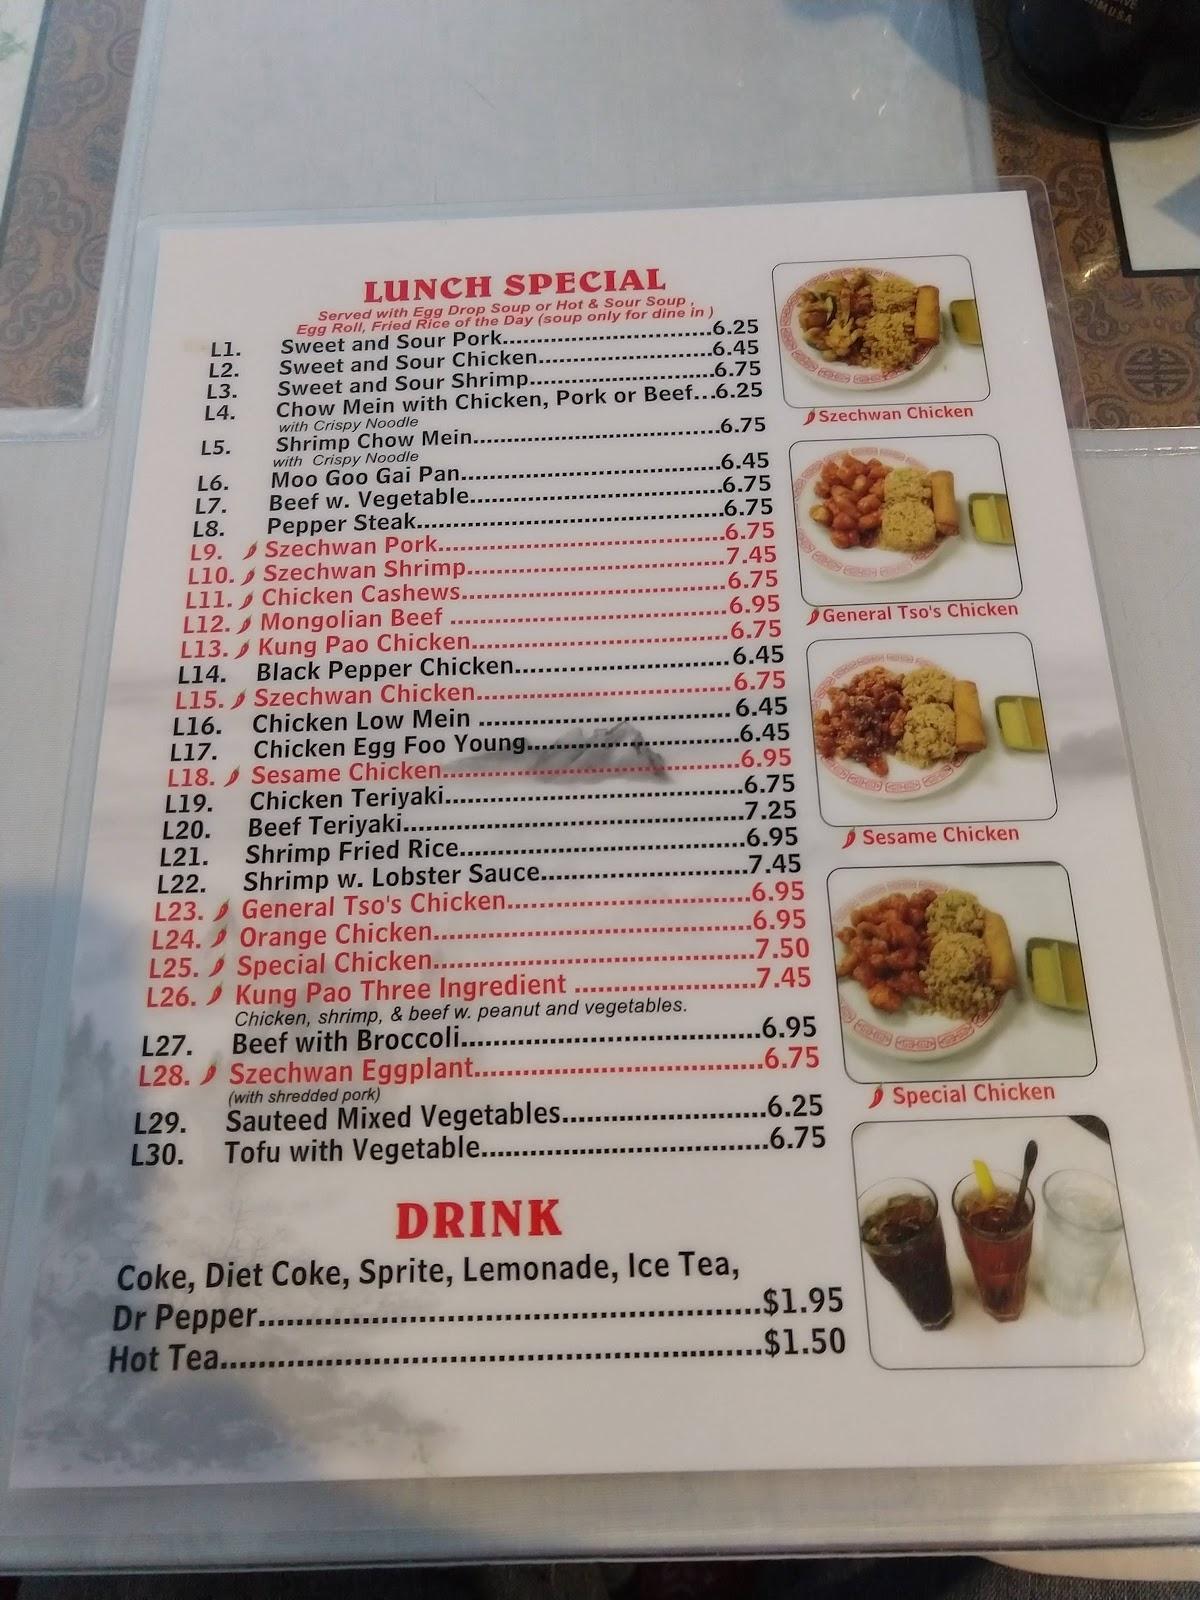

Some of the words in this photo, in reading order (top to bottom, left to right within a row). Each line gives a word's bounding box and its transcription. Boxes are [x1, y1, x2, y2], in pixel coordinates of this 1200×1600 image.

[364, 276, 492, 303] LUNCH
[503, 268, 666, 296] SPECIAL
[296, 324, 327, 337] Egg
[329, 321, 370, 334] Roll,
[371, 319, 412, 332] Fried
[416, 317, 450, 329] Rice
[455, 316, 472, 327] of
[475, 315, 499, 327] the
[503, 314, 534, 327] Day
[537, 311, 583, 325] (soup
[587, 310, 621, 323] only
[625, 309, 648, 320] for
[652, 307, 685, 319] dine
[318, 309, 371, 322] Served
[374, 308, 408, 320] with
[413, 306, 443, 320] Egg
[448, 305, 485, 318] Drop
[491, 303, 530, 316] Soup
[536, 303, 552, 312] or
[556, 300, 583, 311] Hot
[588, 299, 599, 309] &
[604, 298, 641, 309] Sour
[211, 341, 241, 357] L1.
[281, 338, 345, 354] Sweet
[352, 335, 389, 352] and
[396, 334, 446, 349] Sour
[453, 329, 502, 347] Pork
[712, 319, 759, 336] 6.25
[207, 383, 237, 399] L3.
[277, 379, 343, 397] Sweet
[349, 376, 387, 393] and
[395, 375, 445, 391] Sour
[451, 371, 528, 389] Shrimp
[714, 360, 761, 378] 6.75
[205, 404, 235, 421] L4.
[276, 401, 336, 418] Chow
[343, 397, 394, 415] Mein
[402, 395, 447, 412] with
[455, 392, 548, 410] Chicken,
[556, 388, 607, 406] Pork
[614, 391, 637, 403] or
[644, 384, 693, 402] Beef
[714, 381, 763, 399] 6.25
[818, 407, 902, 423] Szechwan
[907, 405, 973, 419] Chicken
[201, 440, 231, 456] L5.
[276, 435, 350, 455] Shrimp
[357, 432, 414, 452] Chow
[422, 429, 472, 446] Mein
[719, 416, 766, 434] 6.75
[279, 421, 308, 433] with
[314, 419, 362, 433] Crispy
[365, 416, 419, 429] Noodle
[197, 474, 229, 492] L6.
[271, 471, 318, 489] Moo
[325, 469, 368, 486] Goo
[376, 466, 411, 484] Gai
[419, 466, 459, 483] Pan
[720, 452, 769, 470] 6.45
[273, 455, 303, 468] with
[313, 454, 362, 468] Crispy
[365, 451, 419, 464] Noodle
[193, 520, 224, 538] L8.
[267, 517, 347, 537] Pepper
[353, 512, 416, 531] Steak
[723, 498, 773, 517] 6.75
[191, 543, 222, 561] L9.
[265, 538, 376, 558] Szechwan
[385, 535, 437, 554] Pork
[724, 521, 775, 541] 6.75
[183, 615, 230, 634] L12.
[261, 610, 382, 633] Mongolian
[391, 607, 443, 627] Beef
[729, 594, 780, 614] 6.95
[822, 606, 892, 623] General
[897, 605, 942, 619] Tso's
[947, 602, 1018, 618] Chicken
[176, 690, 224, 710] L15.
[254, 686, 372, 707] Szechwan
[380, 683, 474, 703] Chicken
[734, 670, 785, 691] 6.75
[170, 742, 217, 762] L17.
[254, 738, 345, 759] Chicken
[354, 737, 396, 759] Egg
[404, 735, 446, 755] Foo
[454, 733, 527, 756] Young
[739, 722, 790, 743] 6.45
[165, 793, 213, 814] L19.
[250, 789, 343, 811] Chicken
[351, 785, 443, 810] Teriyaki
[744, 773, 795, 794] 6.75
[160, 847, 208, 867] L21.
[245, 843, 330, 866] Shrimp
[339, 839, 400, 861] Fried
[408, 838, 458, 859] Rice
[746, 826, 798, 847] 6.95
[863, 829, 937, 845] Sesame
[943, 825, 1019, 843] Chicken
[155, 901, 203, 922] L23.
[242, 896, 335, 919] General
[343, 895, 402, 916] Tso's
[410, 891, 505, 913] Chicken
[751, 880, 804, 902] 6.95
[147, 986, 196, 1008] L26.
[236, 984, 297, 1008] Kung
[306, 982, 351, 1003] Pao
[360, 979, 431, 1001] Three
[440, 974, 566, 1003] Ingredient
[755, 966, 811, 989] 7.45
[235, 1010, 310, 1028] Chicken,
[318, 1008, 382, 1027] shrimp,
[390, 1006, 403, 1022] &
[408, 1004, 451, 1021] beef
[454, 1007, 471, 1020] w.
[477, 1001, 541, 1022] peanut
[545, 999, 579, 1016] and
[585, 997, 687, 1018] vegetables.
[141, 1034, 192, 1057] L27.
[232, 1031, 288, 1055] Beef
[295, 1029, 348, 1053] with
[357, 1025, 459, 1051] Broccoli
[762, 1015, 817, 1039] 6.95
[139, 1064, 190, 1087] L28.
[229, 1061, 353, 1085] Szechwan
[363, 1056, 474, 1085] Eggplant
[764, 1046, 819, 1069] 6.75
[228, 1090, 264, 1105] (with
[268, 1088, 339, 1103] shredded
[341, 1086, 381, 1105] pork)
[893, 1084, 967, 1108] Special
[974, 1082, 1055, 1102] Chicken
[131, 1142, 184, 1167] L30.
[224, 1140, 280, 1164] Tofu
[289, 1138, 343, 1162] with
[352, 1135, 480, 1165] Vegetable
[769, 1125, 826, 1150] 6.75
[396, 1199, 563, 1239] DRINK
[117, 1263, 195, 1294] Coke,
[205, 1261, 264, 1288] Diet
[272, 1259, 350, 1290] Coke,
[359, 1257, 453, 1289] Sprite,
[464, 1253, 618, 1284] Lemonade,
[629, 1252, 670, 1278] Ice
[678, 1250, 739, 1281] Tea,
[112, 1304, 147, 1332] Dr
[155, 1303, 258, 1335] Pepper
[763, 1286, 843, 1317] $1.95
[108, 1345, 160, 1373] Hot
[168, 1343, 218, 1371] Tea
[764, 1327, 846, 1358] $1.50
